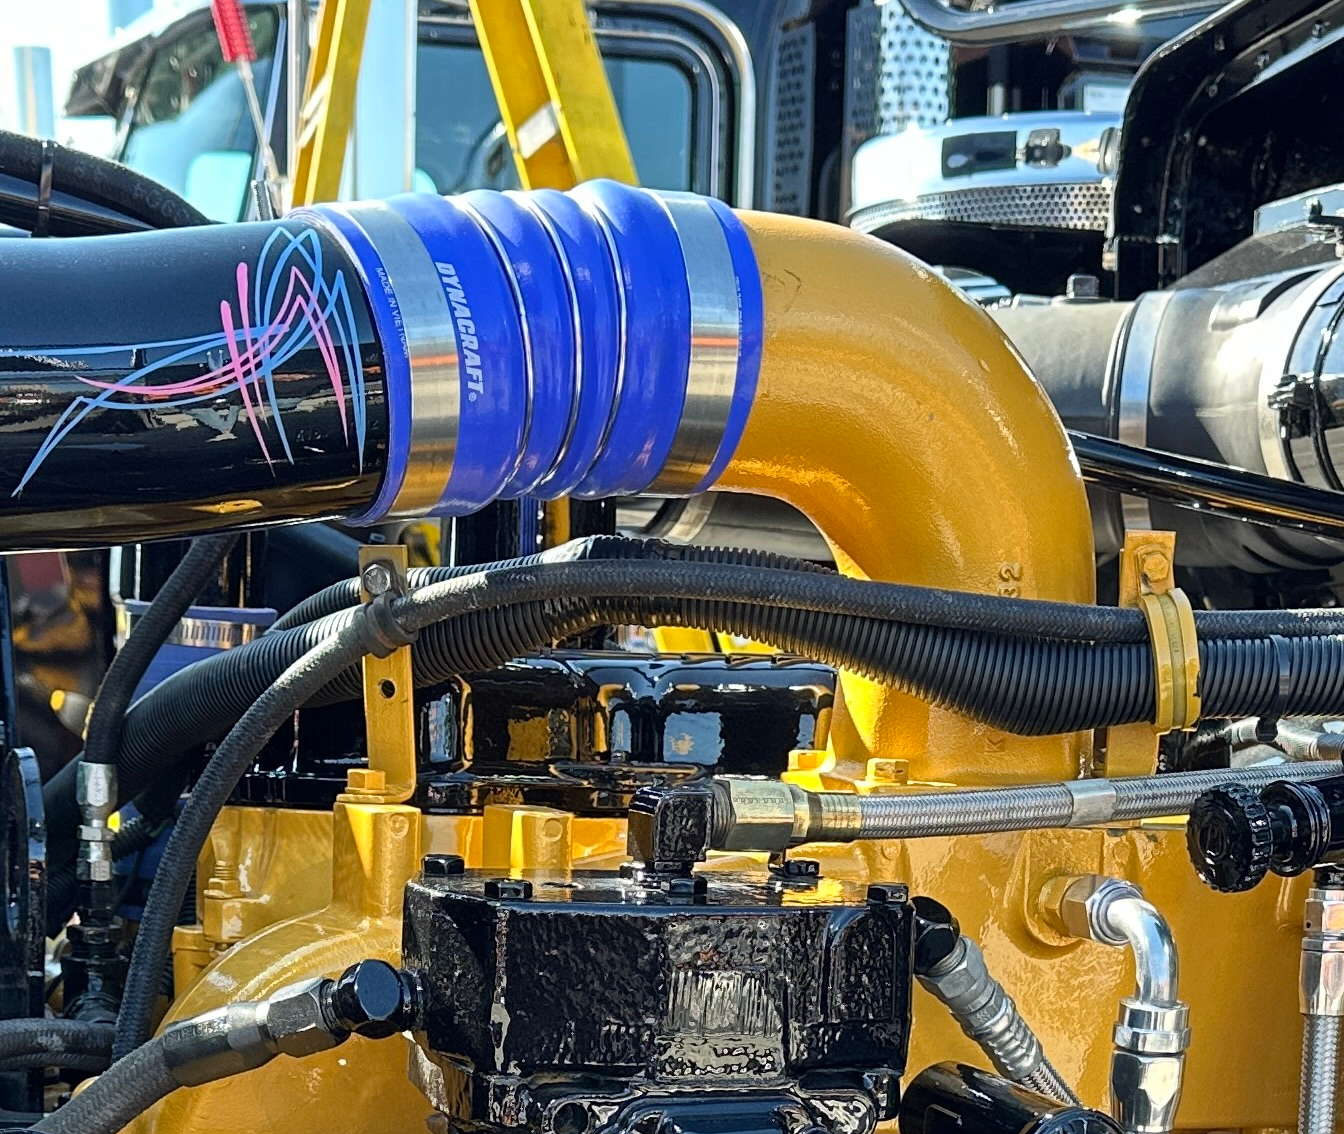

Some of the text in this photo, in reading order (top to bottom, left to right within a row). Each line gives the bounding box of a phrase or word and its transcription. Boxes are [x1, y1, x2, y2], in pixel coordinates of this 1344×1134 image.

[374, 266, 393, 295] MADE
[388, 297, 399, 308] IN
[434, 261, 485, 395] DYNACRAFT
